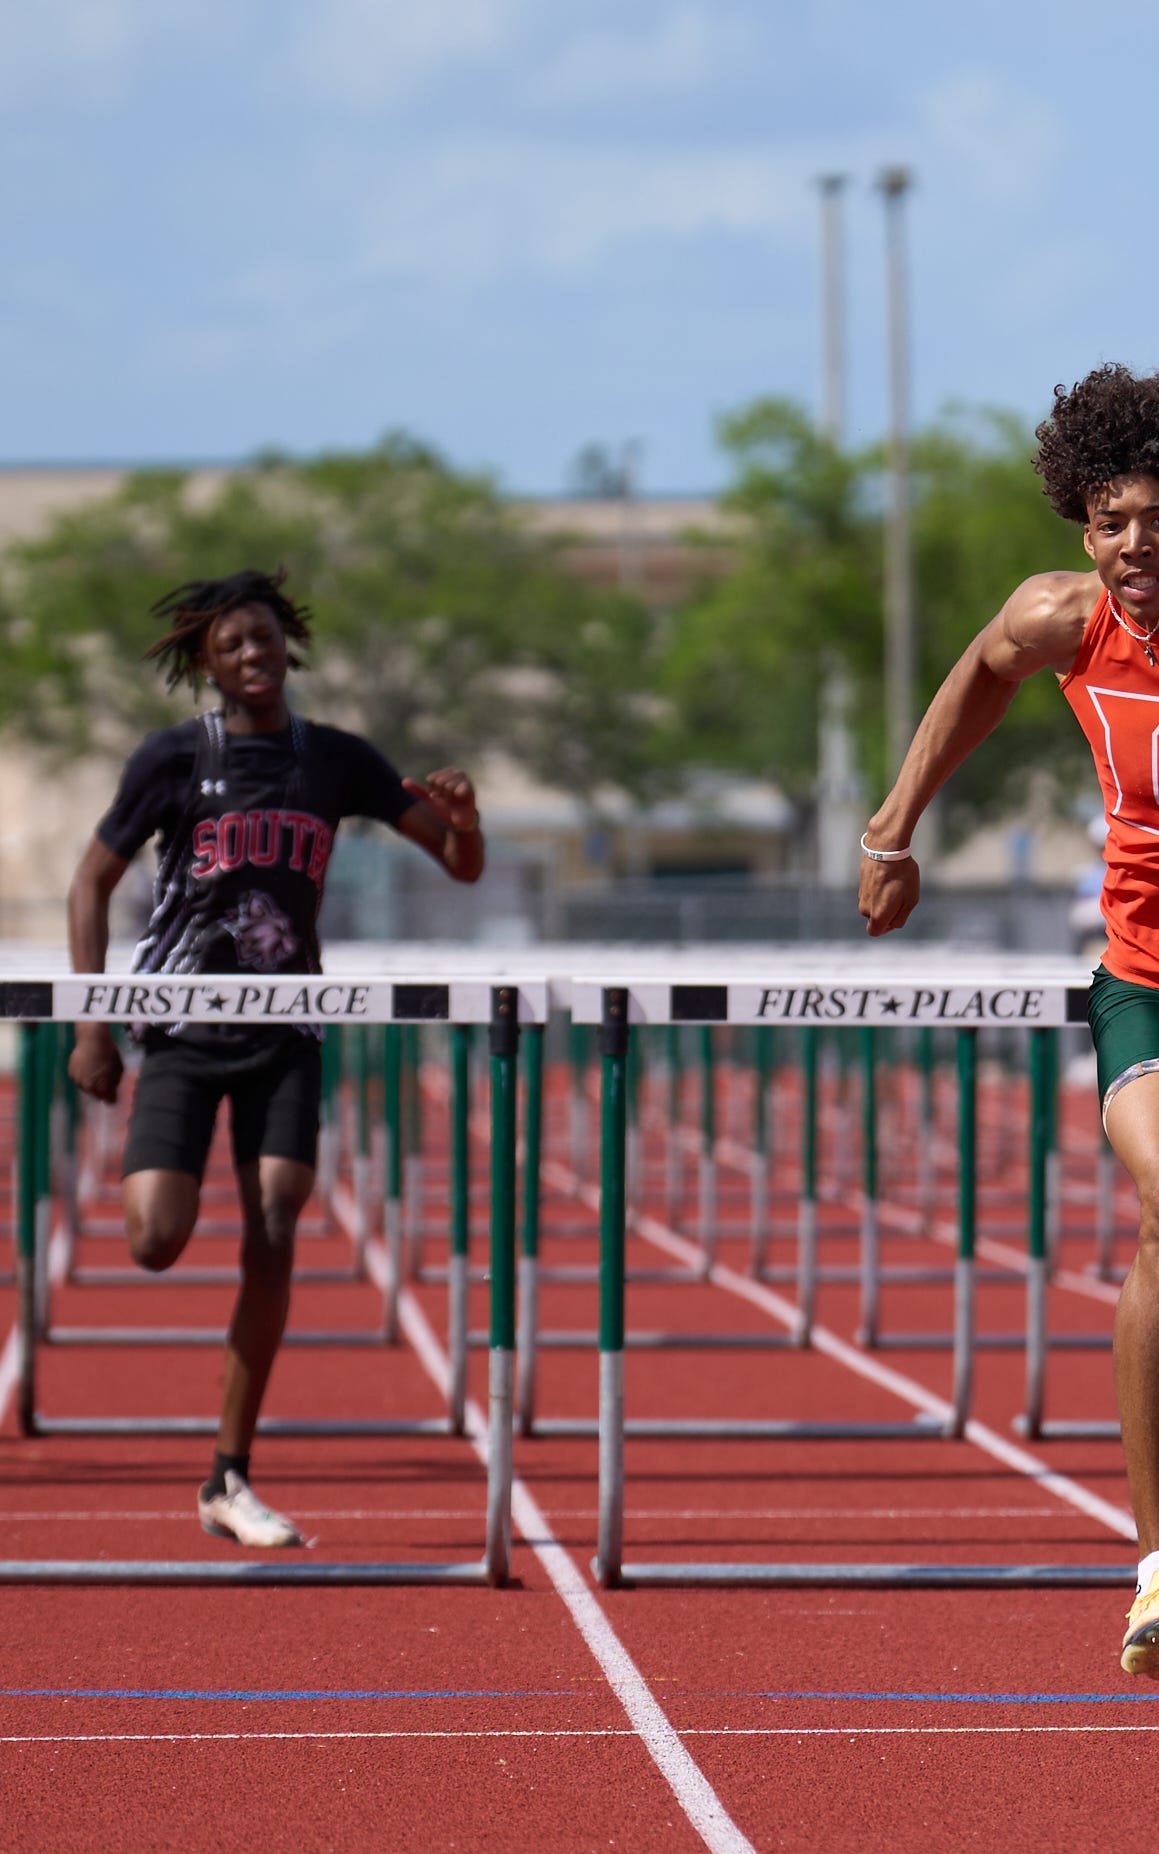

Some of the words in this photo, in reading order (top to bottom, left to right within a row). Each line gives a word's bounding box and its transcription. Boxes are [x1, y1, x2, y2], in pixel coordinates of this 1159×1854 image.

[81, 985, 205, 1015] FIRST
[233, 986, 370, 1015] PLACE
[756, 988, 879, 1018] FIRST
[909, 989, 1044, 1018] PLACE
